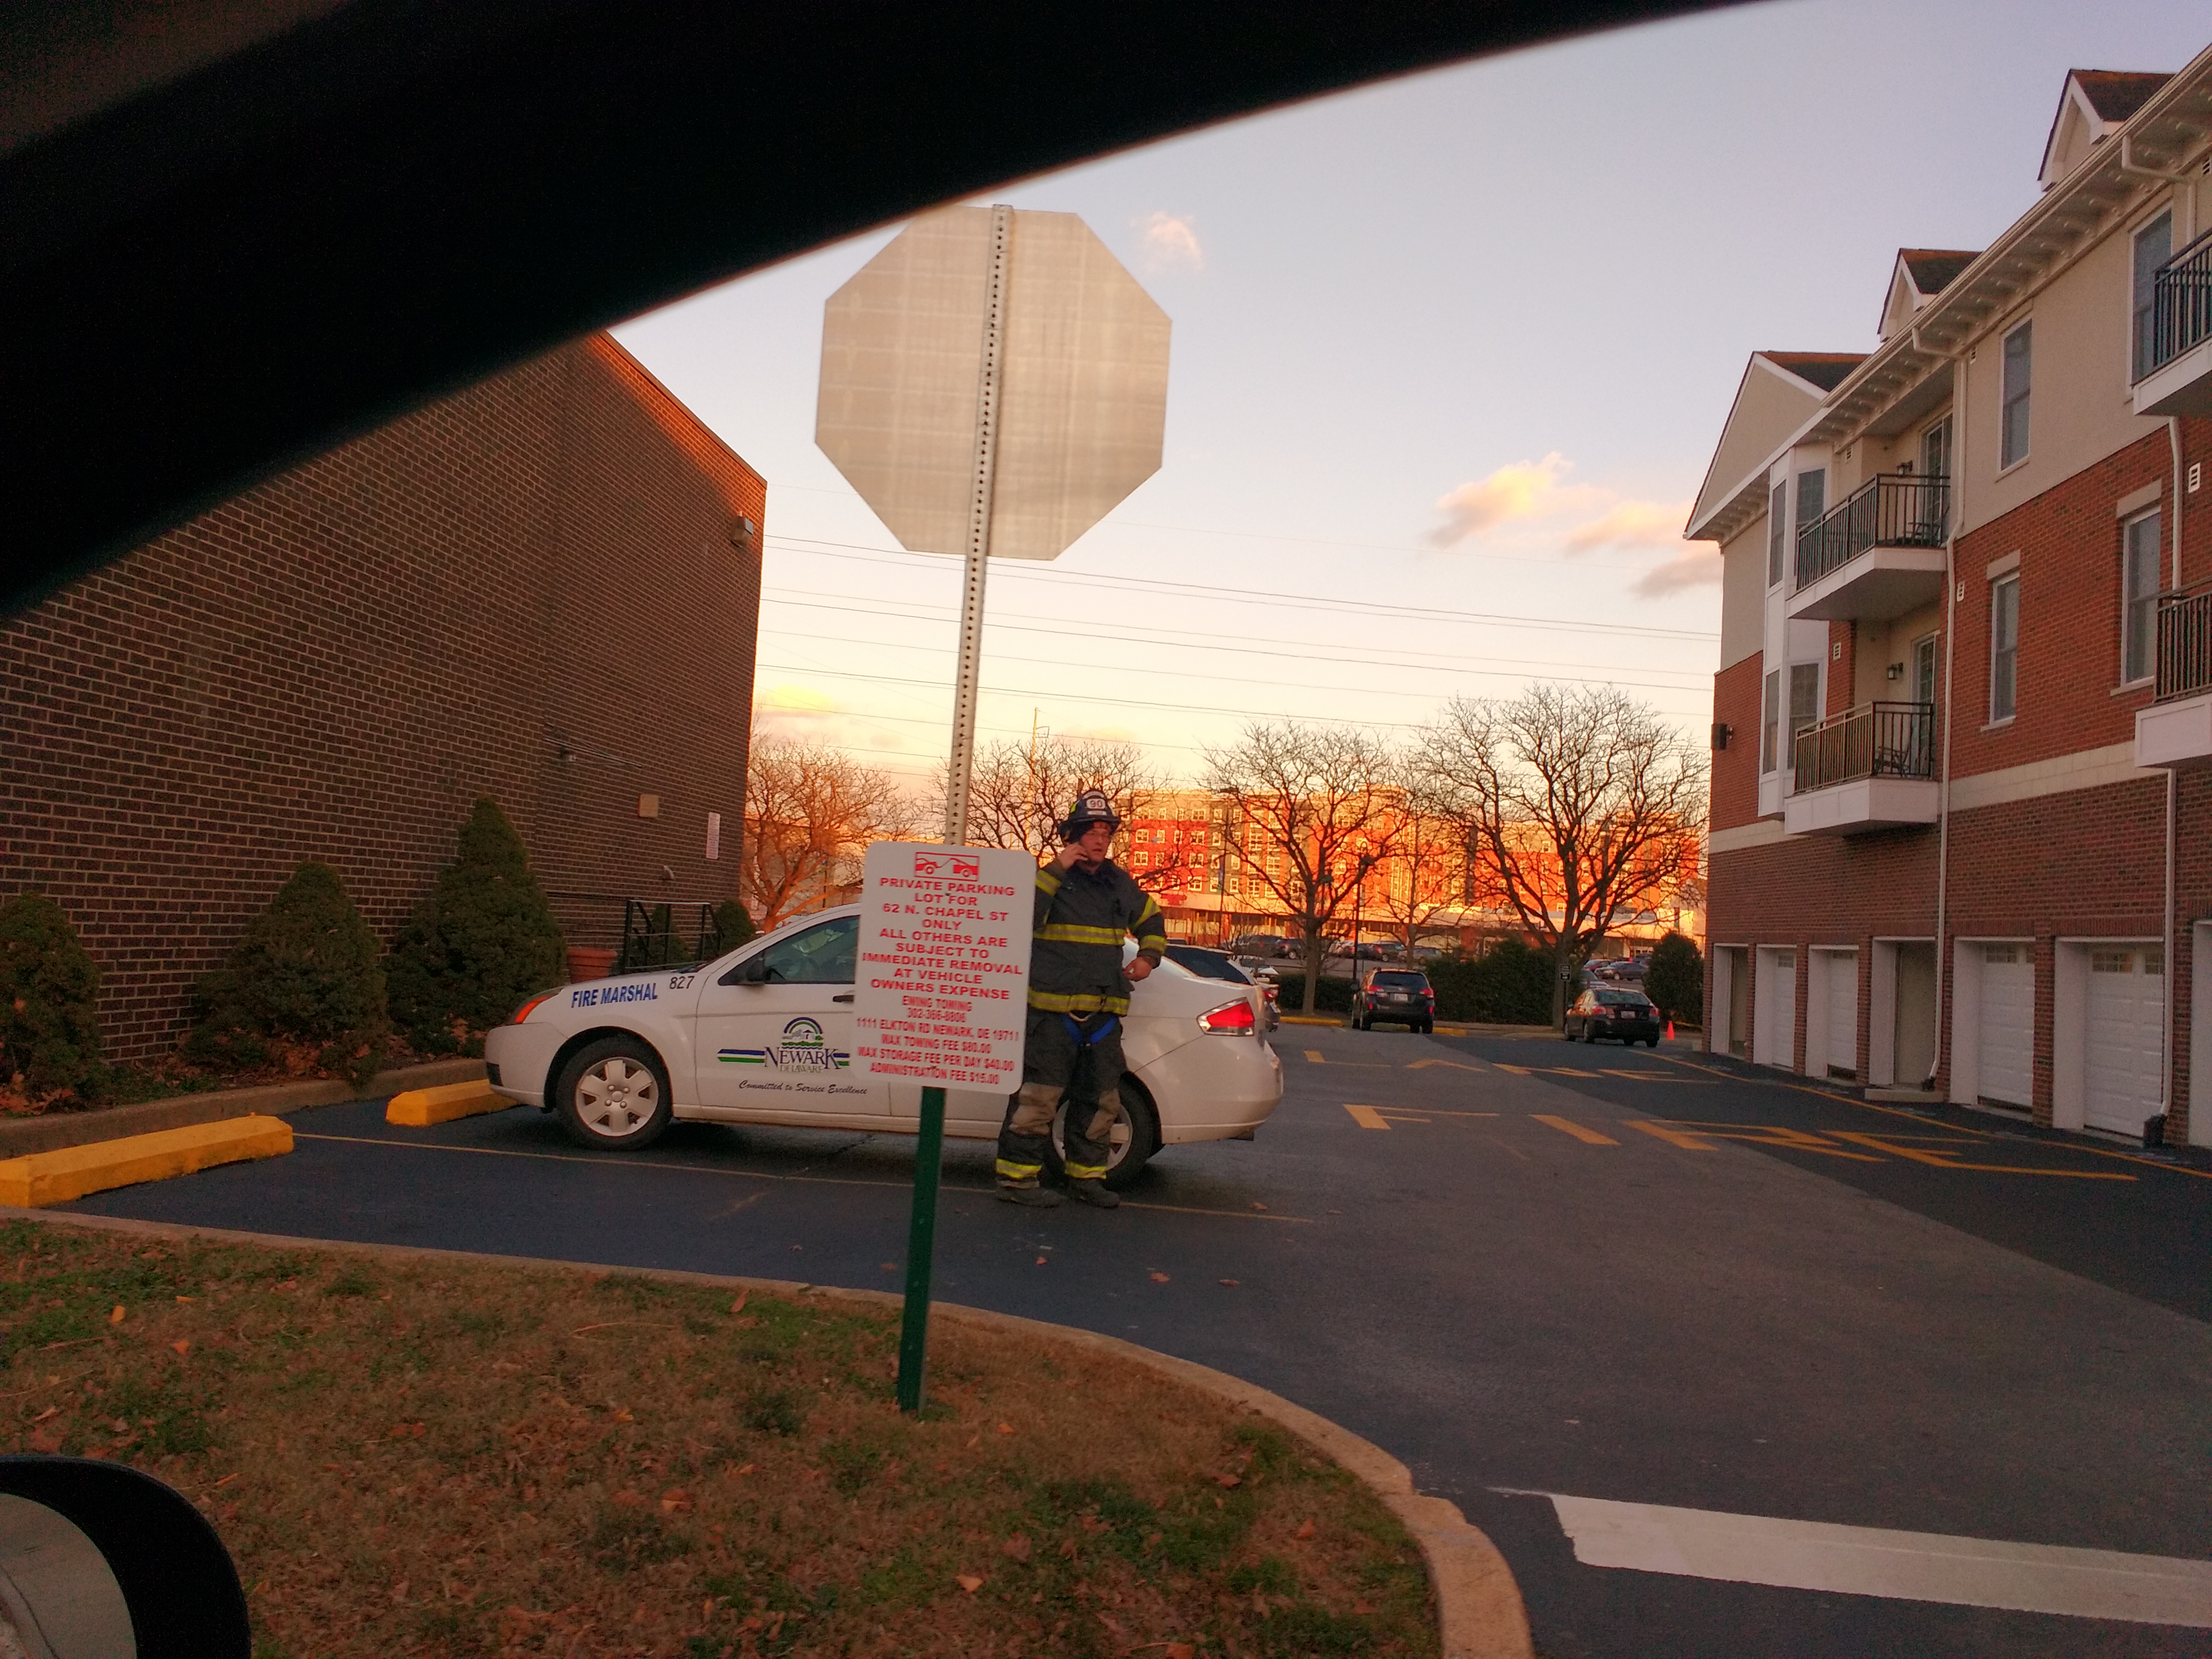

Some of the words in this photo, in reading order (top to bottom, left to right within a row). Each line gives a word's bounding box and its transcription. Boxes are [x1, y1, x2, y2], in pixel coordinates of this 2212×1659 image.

[880, 877, 943, 891] PRIVATE
[948, 882, 1015, 896] PARKING
[915, 893, 943, 903] LOT
[948, 895, 977, 906] FOR
[883, 903, 900, 913] 62
[905, 905, 919, 914] N.
[925, 907, 984, 920] CHAPEL
[990, 911, 1009, 921] ST
[922, 919, 961, 930] ONLY
[879, 928, 907, 939] ALL
[912, 931, 972, 944] OTHERS
[977, 936, 1008, 947] ARE
[896, 943, 965, 957] SUBJECT
[970, 948, 989, 958] TO
[862, 952, 944, 968] IMMEDIATE
[950, 960, 1023, 975] REMOVAL
[669, 976, 695, 989] 827
[894, 968, 913, 978] AT
[918, 970, 983, 984] VEHICLE
[571, 989, 598, 1008] FIRE
[600, 983, 658, 1004] MARSHAL
[870, 979, 934, 993] OWNERS
[940, 984, 1010, 1000] EXPENSE
[902, 995, 932, 1007] EWING
[936, 999, 971, 1011] TOWING
[857, 1018, 876, 1028] 1111
[881, 1019, 916, 1032] ELKTON
[918, 1023, 930, 1033] RD
[933, 1025, 974, 1039] NEWARK,
[977, 1028, 990, 1038] DE
[993, 1029, 1018, 1041] 19711
[882, 1034, 901, 1045] MAX
[904, 1036, 939, 1049] TOWING
[942, 1040, 959, 1050] FEE
[764, 1047, 841, 1069] NEWARK
[858, 1046, 877, 1058] MAX
[881, 1048, 922, 1062] STORAGE
[925, 1053, 941, 1063] FEE
[944, 1054, 961, 1066] PER
[964, 1056, 983, 1067] DAY
[869, 1062, 946, 1078] ADMINISTRATION
[950, 1070, 966, 1080] FEE
[1304, 1050, 1719, 1084] LANE
[739, 1080, 783, 1090] Committed
[796, 1083, 824, 1092] Service
[828, 1084, 867, 1094] Excellence
[1343, 1104, 2139, 1182] FIRE
